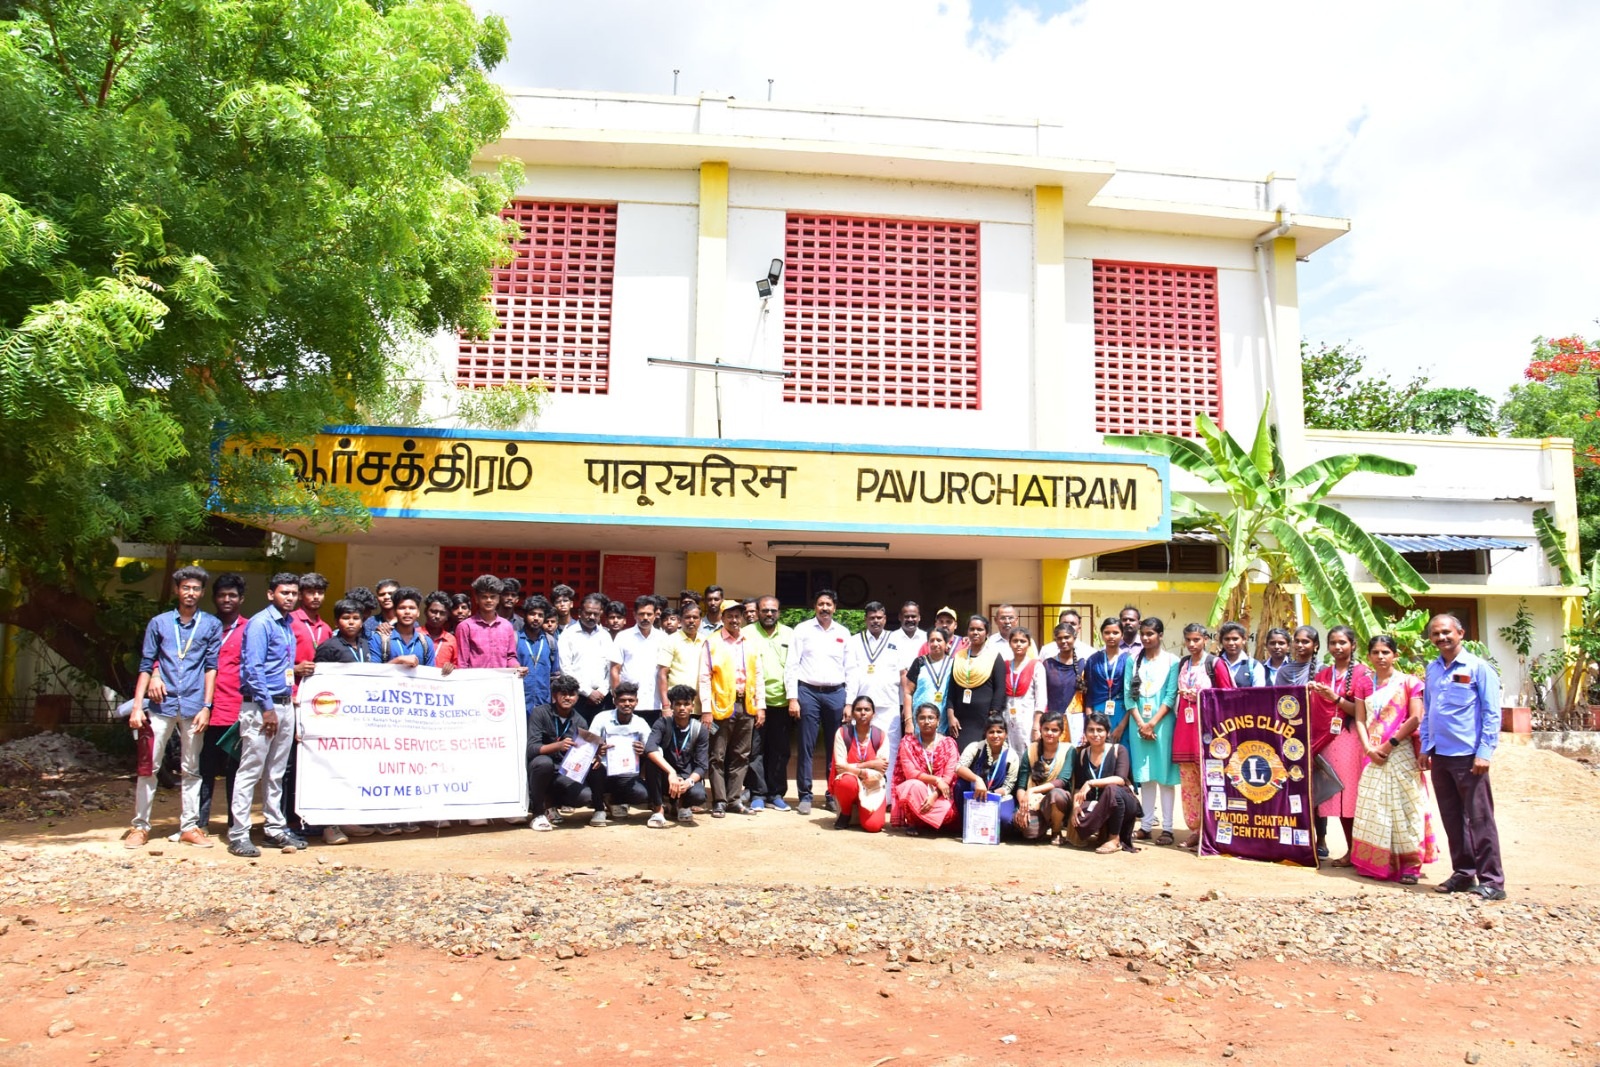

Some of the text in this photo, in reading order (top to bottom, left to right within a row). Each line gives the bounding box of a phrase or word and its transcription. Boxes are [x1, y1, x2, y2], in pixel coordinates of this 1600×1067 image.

[856, 467, 1137, 511] PAVURCHATRAM
[366, 689, 455, 707] EINSTEIN
[342, 704, 482, 719] COLLEGE OF ARTS & SCIENCE
[1213, 715, 1296, 739] LIONS CLUB
[318, 736, 506, 752] NATIONAL SERVICE SCHEME
[1243, 743, 1272, 757] LIONS
[378, 762, 406, 775] UNIT
[408, 762, 427, 775] NO:
[1247, 758, 1266, 783] L
[393, 785, 412, 797] ME
[415, 783, 439, 796] BUT
[1214, 811, 1297, 827] PAVOOR CHATRAM
[1233, 826, 1279, 839] CENTRAL
